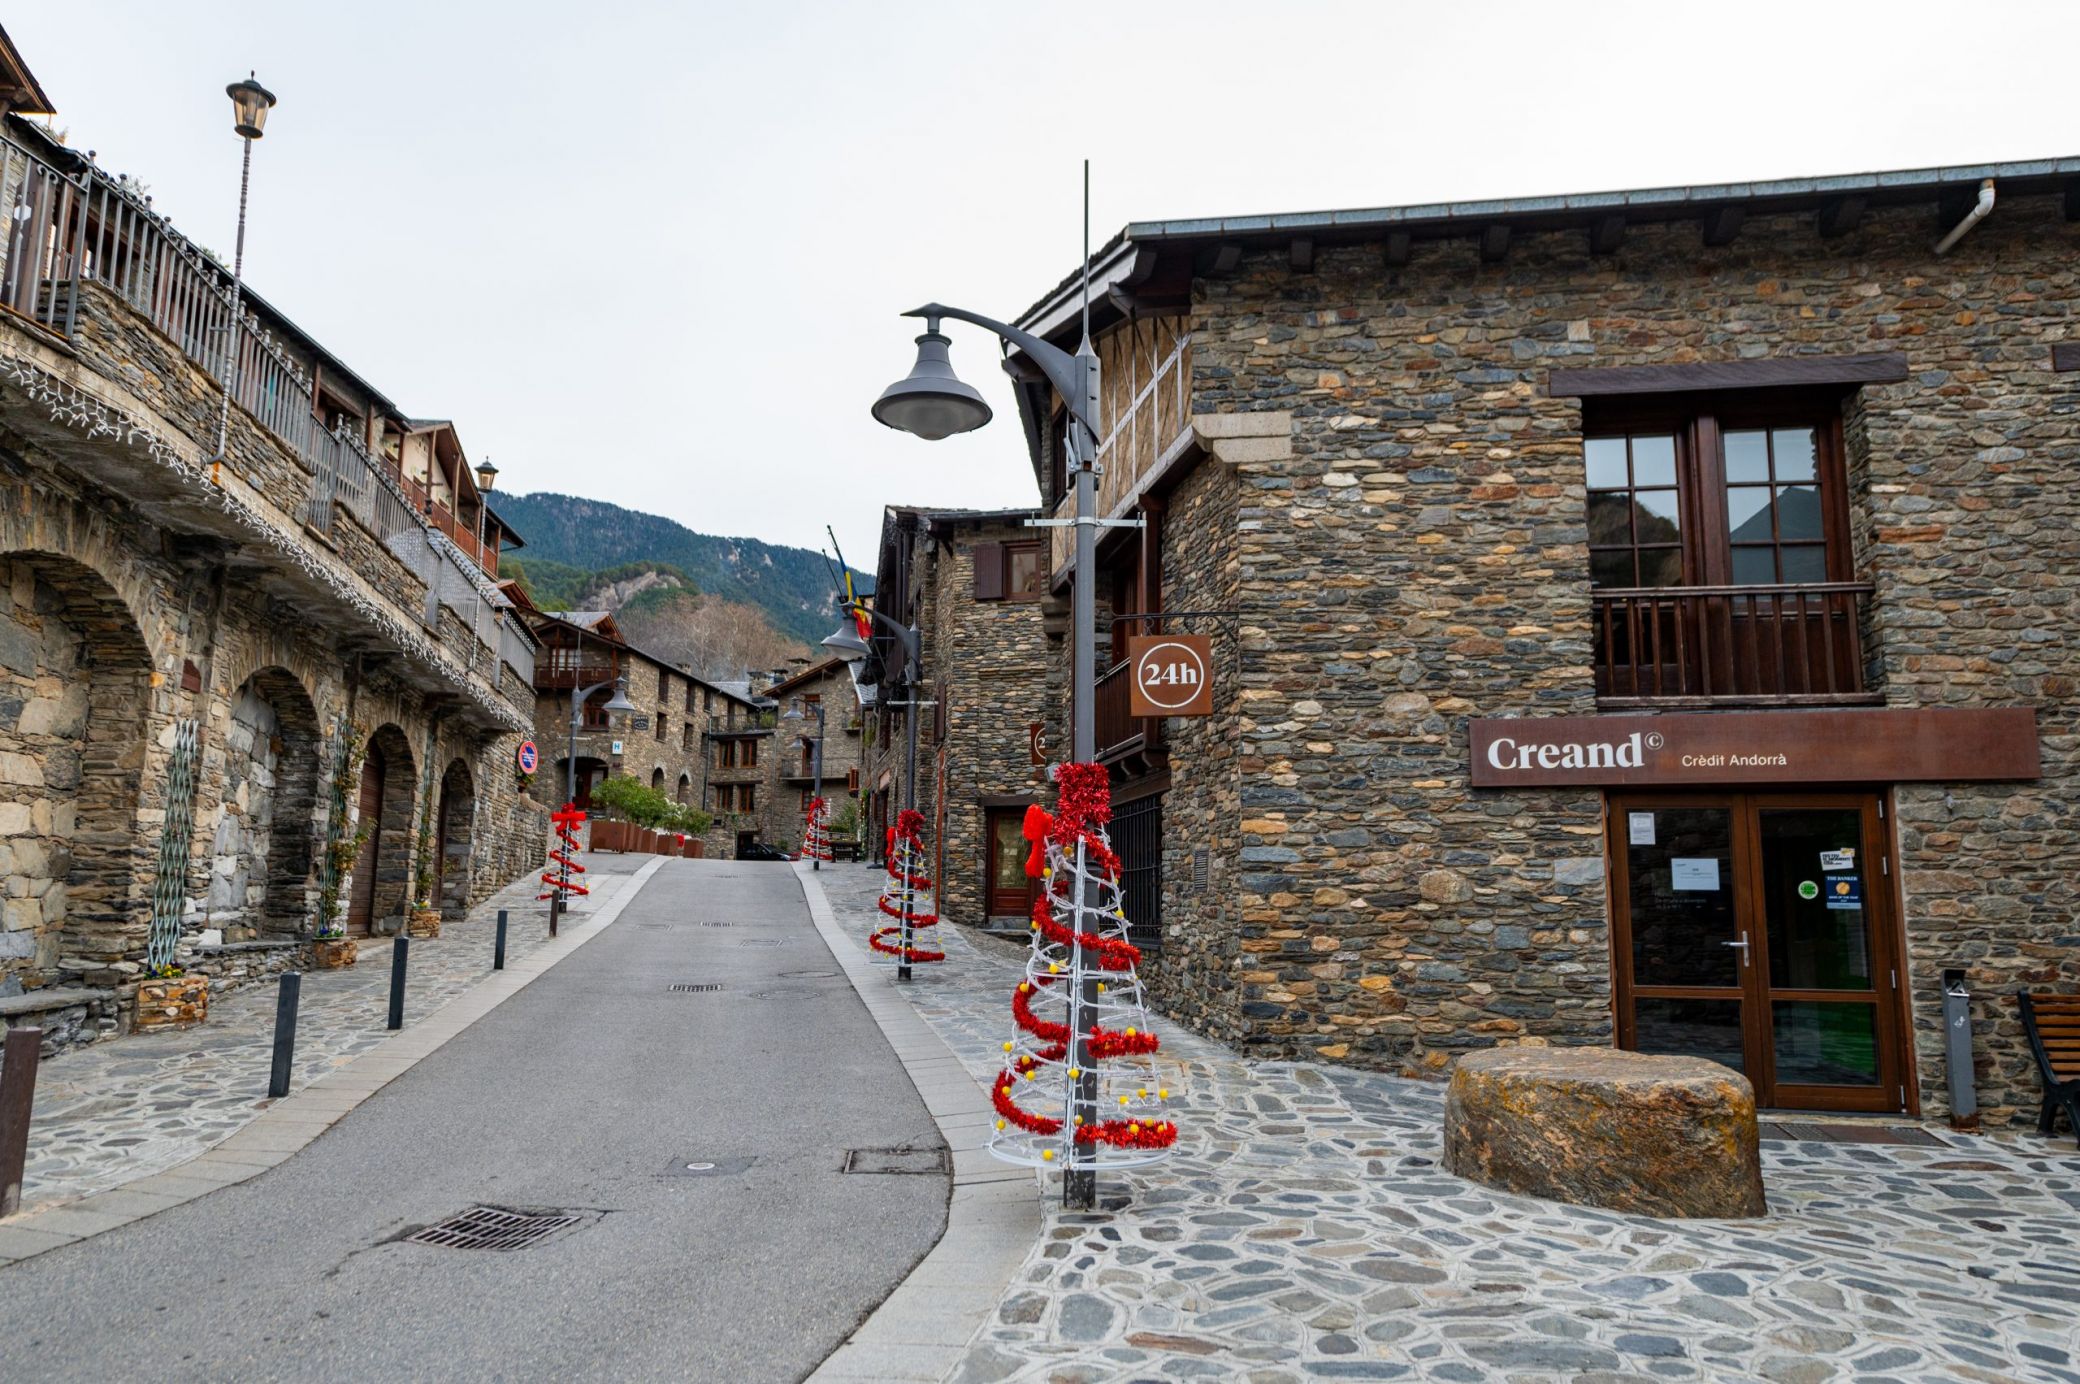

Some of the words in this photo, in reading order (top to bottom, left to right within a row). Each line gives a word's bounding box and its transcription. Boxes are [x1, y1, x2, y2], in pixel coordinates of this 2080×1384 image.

[1144, 662, 1198, 686] 24h
[1487, 732, 1645, 770] Creand
[1681, 754, 1725, 767] Crèdit
[1729, 752, 1788, 767] Andorrà
